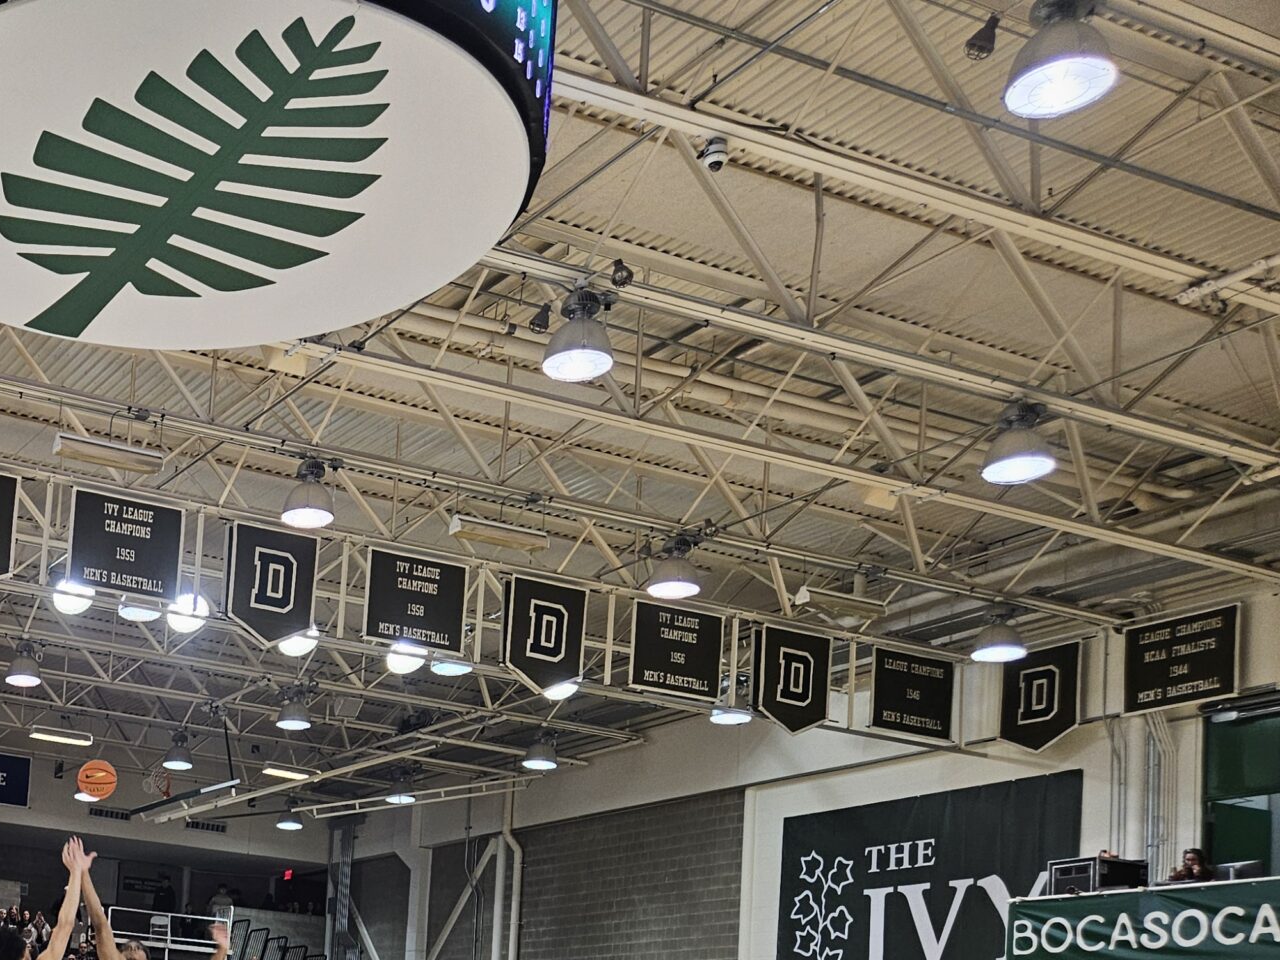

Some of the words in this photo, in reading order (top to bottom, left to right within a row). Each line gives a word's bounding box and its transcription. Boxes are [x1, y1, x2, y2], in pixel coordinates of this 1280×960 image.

[104, 502, 120, 516] IVY
[122, 506, 154, 524] LEAGUE
[104, 520, 151, 540] CHAMPIONS
[116, 547, 136, 562] 1959
[83, 566, 108, 582] MEN'S
[111, 572, 164, 594] BASKETBALL
[250, 546, 297, 614] D
[396, 560, 410, 574] IVY
[413, 564, 441, 580] LEAGUE
[398, 577, 438, 595] CHAMPIONS
[407, 603, 424, 617] 1958
[659, 612, 671, 624] IVY
[674, 615, 700, 630] LEAGUE
[378, 622, 400, 636] MEN'S
[402, 626, 450, 646] BASKETBALL
[526, 598, 568, 663] D
[660, 628, 698, 644] CHAMPIONS
[1139, 628, 1170, 644] LEAGUE
[1175, 618, 1222, 637] CHAMPIONS
[1144, 648, 1166, 663] NCAA
[1172, 638, 1216, 658] FINALISTS
[776, 646, 814, 707] D
[884, 658, 908, 672] LEAGUE
[910, 662, 944, 678] CHAMPIONS
[644, 670, 664, 684] MEN'S
[666, 673, 709, 692] BASKETBALL
[1138, 688, 1162, 703] MEN'S
[1166, 677, 1220, 698] BASKETBALL
[1018, 664, 1060, 726] D
[882, 710, 902, 722] MEN'S
[902, 714, 942, 730] BASKETBALL
[864, 838, 936, 874] THE
[1012, 904, 1280, 956] BOCASOCA
